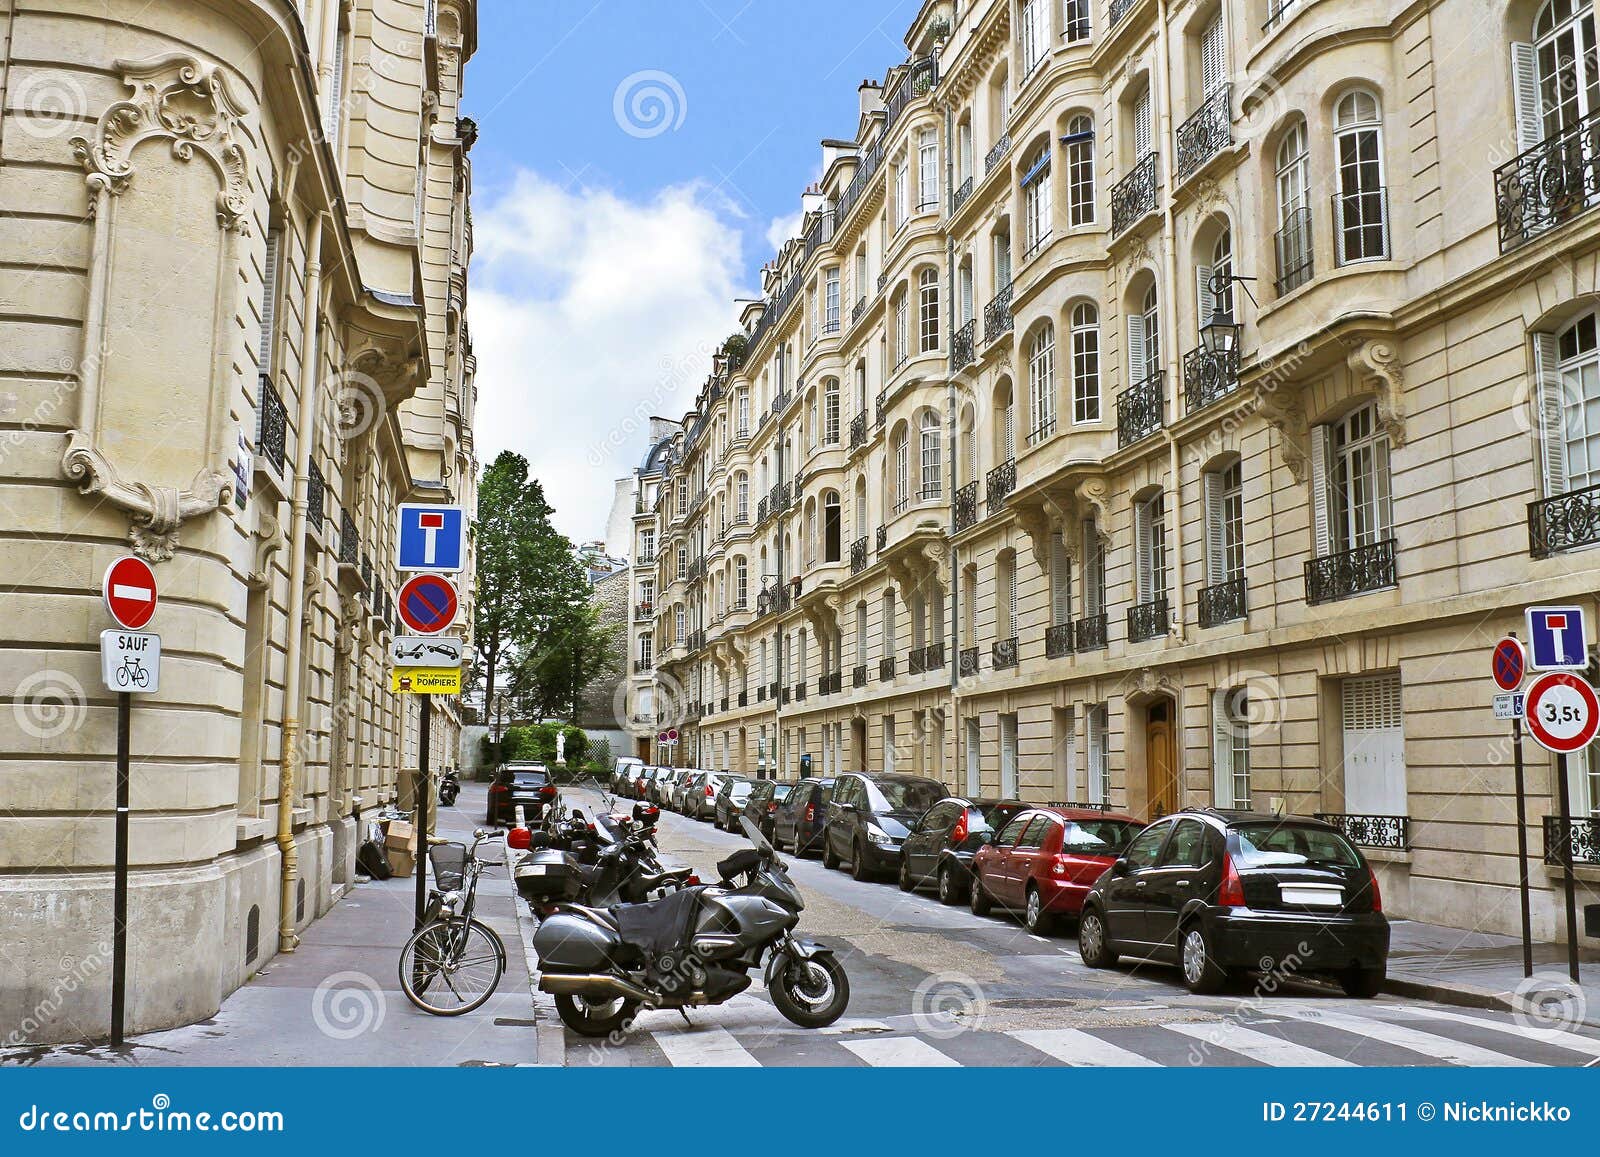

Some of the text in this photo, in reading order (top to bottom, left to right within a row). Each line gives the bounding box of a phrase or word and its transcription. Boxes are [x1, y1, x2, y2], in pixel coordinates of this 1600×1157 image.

[118, 636, 149, 651] SAUF
[417, 678, 457, 687] POMPIERS
[1544, 703, 1581, 725] 3,5t
